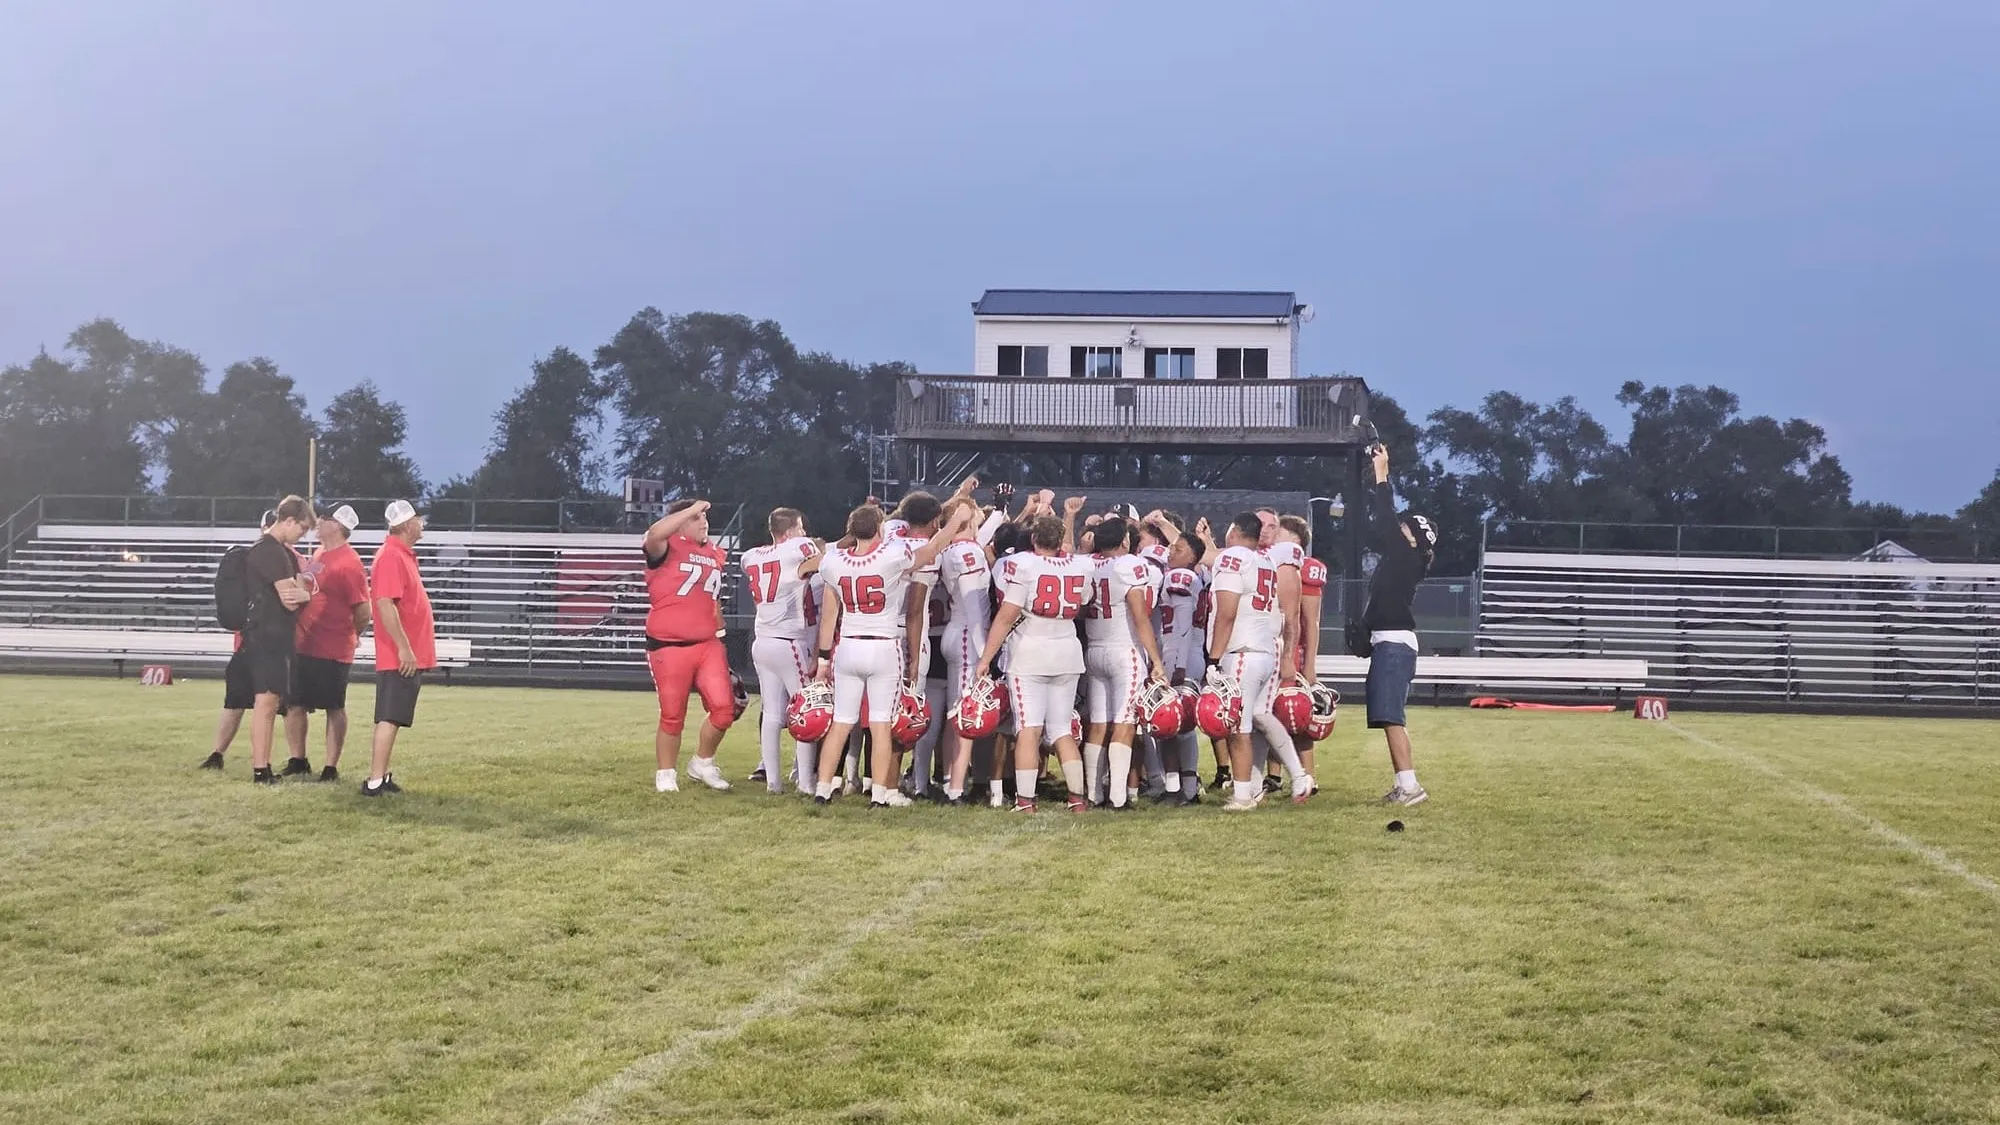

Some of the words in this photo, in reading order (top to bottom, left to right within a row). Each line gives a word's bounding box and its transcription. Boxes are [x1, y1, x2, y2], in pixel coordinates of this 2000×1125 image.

[962, 551, 976, 567] 5
[1219, 554, 1243, 572] 55
[676, 562, 722, 601] 74
[837, 574, 886, 614] 16
[1031, 574, 1085, 619] 85
[141, 667, 165, 687] 40
[1642, 699, 1665, 721] 40
